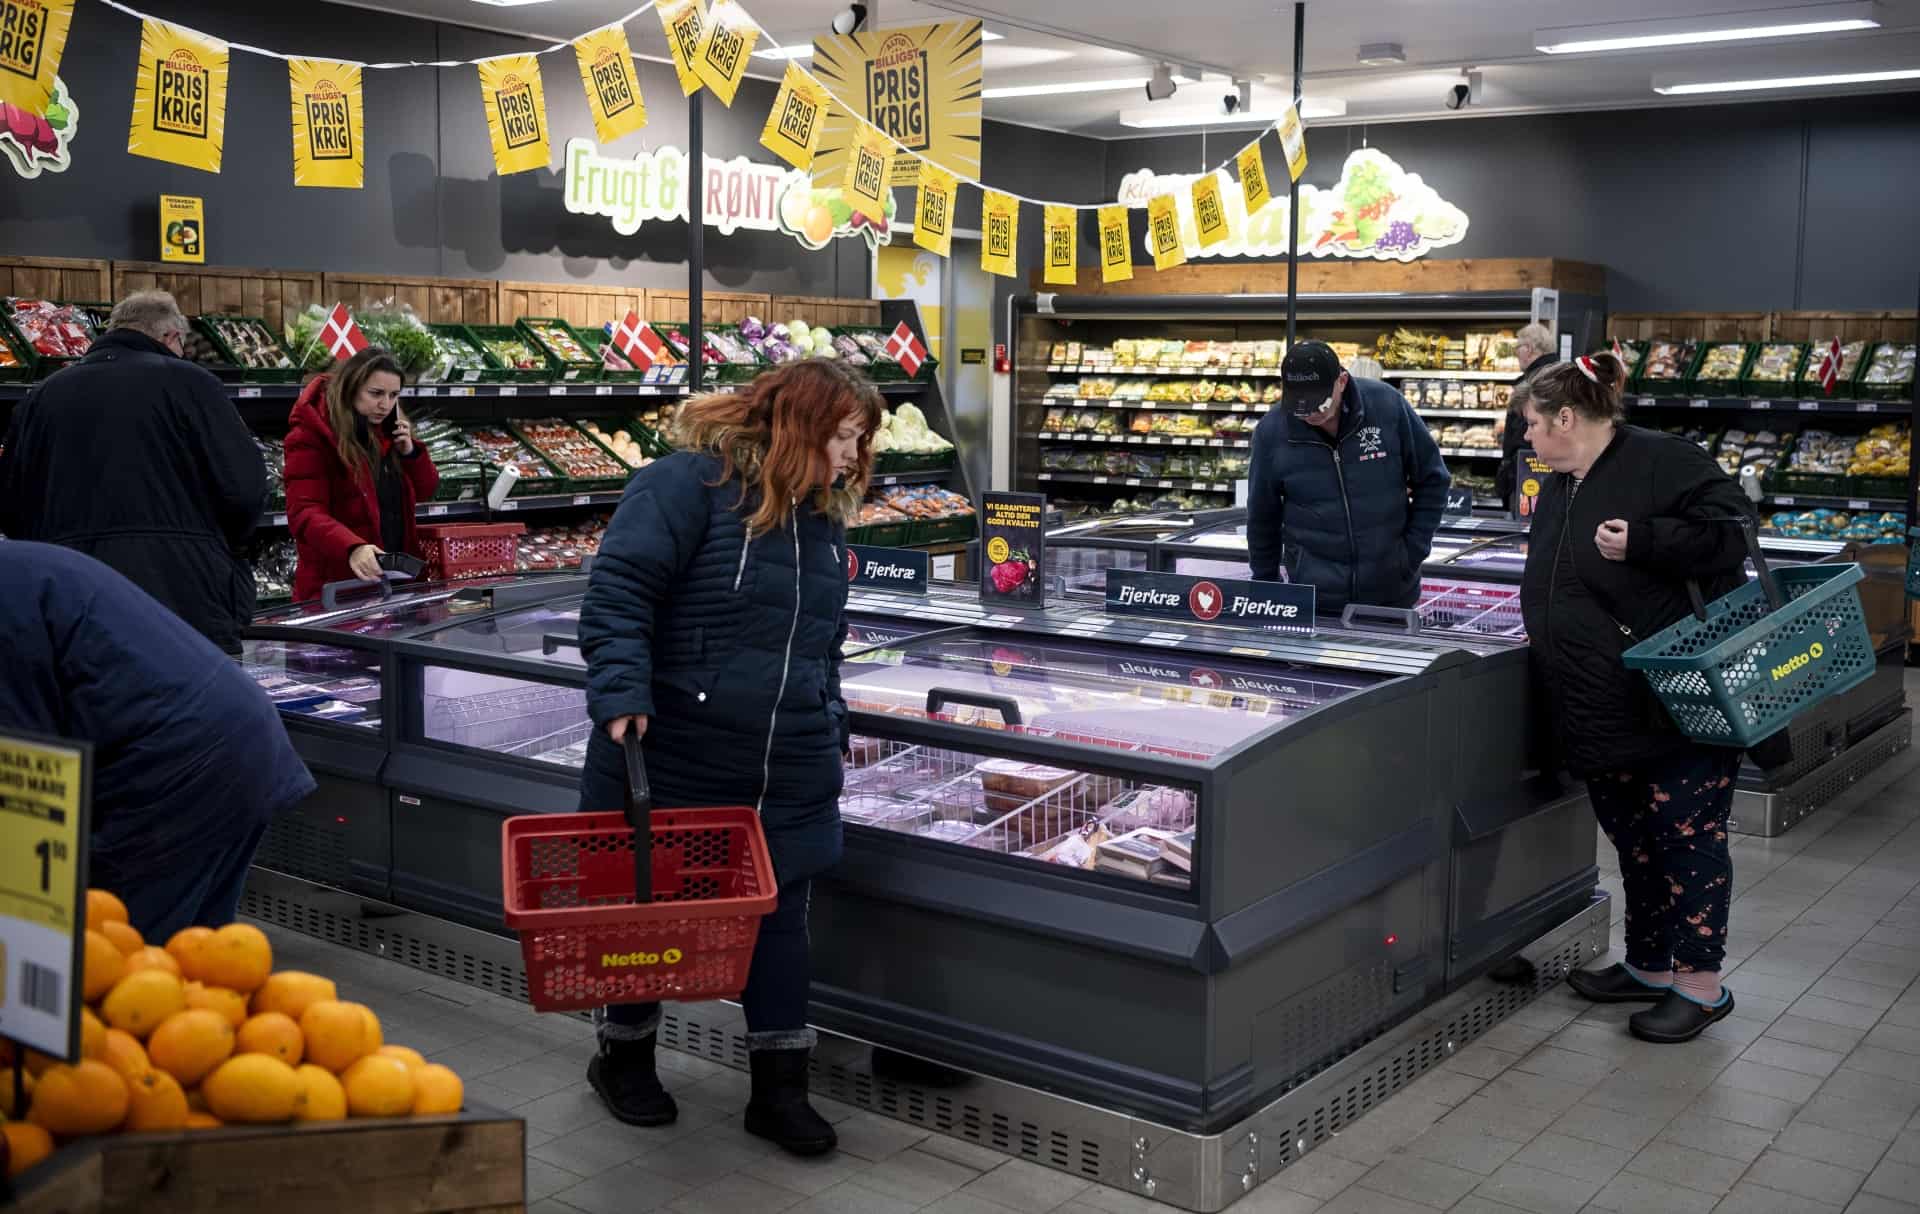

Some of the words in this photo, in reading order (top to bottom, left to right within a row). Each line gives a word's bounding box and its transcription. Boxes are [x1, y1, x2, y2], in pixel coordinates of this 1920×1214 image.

[0, 29, 34, 64] RIG
[716, 25, 739, 55] PRIS
[165, 61, 203, 73] BILLIGST
[711, 41, 734, 72] KRIG
[876, 48, 920, 69] BILLIGST
[162, 70, 203, 101] PRIS
[596, 61, 622, 89] PRIS
[873, 64, 921, 106] PRIS
[501, 92, 531, 118] PRIS
[602, 80, 629, 109] KRIG
[161, 95, 203, 127] KRIG
[311, 102, 345, 125] PRIS
[789, 96, 812, 122] PRIS
[874, 101, 922, 137] KRIG
[507, 113, 535, 139] KRIG
[783, 112, 808, 139] KRIG
[314, 126, 347, 149] KRIG
[860, 153, 881, 177] PRIS
[573, 149, 652, 225] Frugt
[659, 157, 679, 211] &
[687, 167, 780, 224] RØNT
[857, 169, 878, 193] KRIG
[926, 191, 944, 211] PRIS
[1200, 197, 1215, 212] PRIS
[924, 209, 942, 227] KRIG
[991, 219, 1008, 235] PRIS
[1156, 217, 1171, 232] PRIS
[1202, 209, 1218, 225] KRIG
[991, 234, 1008, 250] KRIG
[1054, 230, 1069, 244] PRIS
[1106, 229, 1121, 242] PRIS
[1158, 230, 1174, 246] KRIG
[1054, 245, 1069, 260] KRIG
[1107, 243, 1123, 257] KRIG
[995, 503, 1041, 513] GARANTERER
[995, 511, 1016, 519] ALTID
[986, 518, 1006, 526] GODE
[1006, 519, 1040, 529] KVALITET
[863, 560, 916, 580] Fjerkræ
[1118, 585, 1181, 606] Fjerkræ
[1231, 596, 1299, 618] Fjerkræ
[1770, 653, 1810, 681] Netto
[601, 952, 660, 968] Netto
